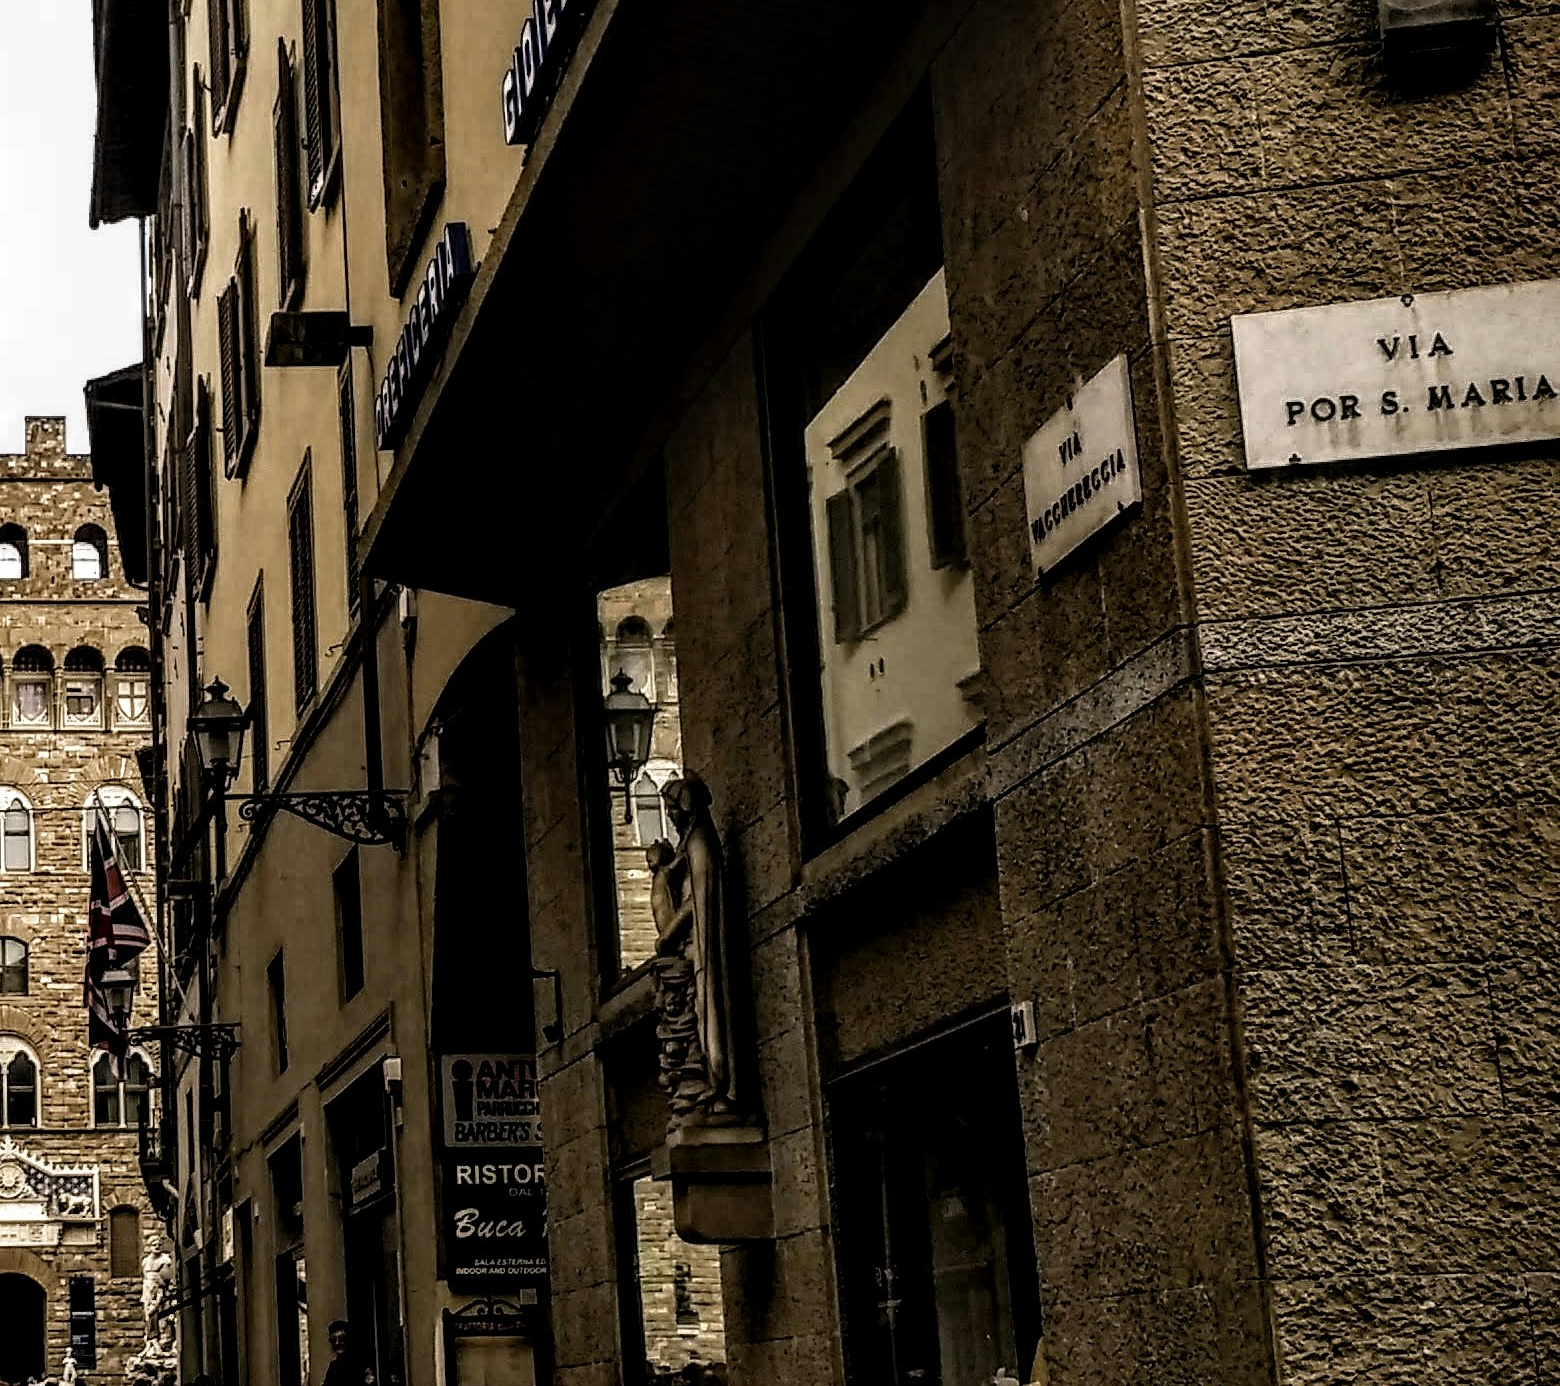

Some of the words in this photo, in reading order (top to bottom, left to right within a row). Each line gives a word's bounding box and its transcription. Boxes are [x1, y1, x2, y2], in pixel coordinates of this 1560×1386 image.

[376, 222, 455, 451] OREFICERIA
[1377, 332, 1454, 363] VIA
[1286, 394, 1363, 426] POR
[1380, 391, 1410, 415] S.
[1426, 373, 1560, 412] MARIA
[1058, 431, 1083, 468] VIA
[454, 1121, 532, 1143] BARBER'S
[454, 1207, 527, 1239] Buca
